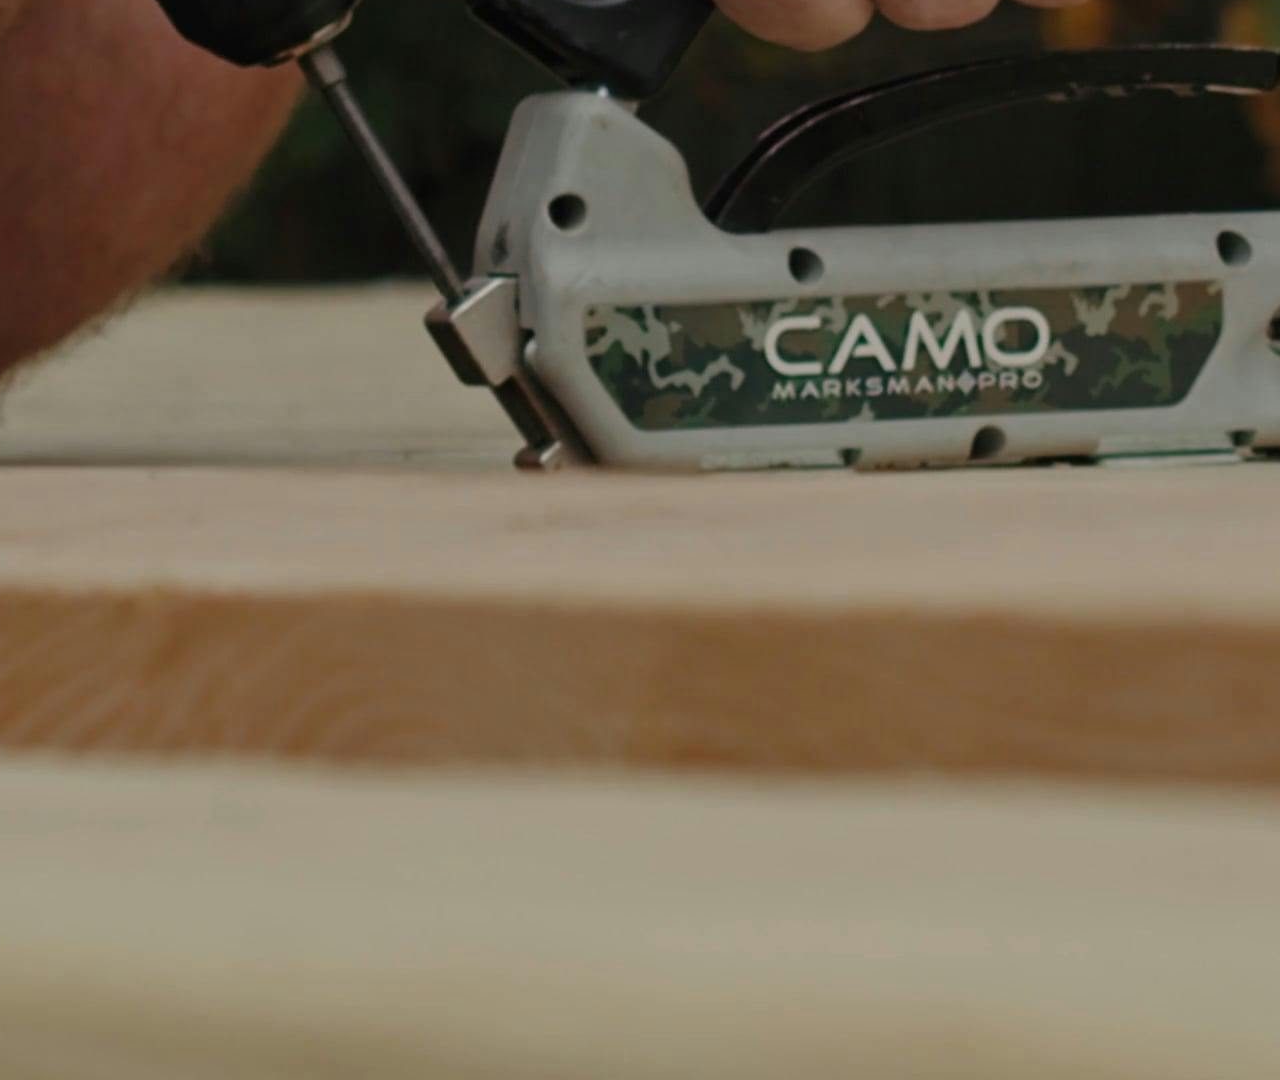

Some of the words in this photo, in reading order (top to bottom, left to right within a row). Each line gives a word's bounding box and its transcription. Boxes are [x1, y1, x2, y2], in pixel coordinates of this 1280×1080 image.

[764, 306, 1051, 377] CAMO
[771, 374, 956, 401] MARKSMAN
[977, 369, 1043, 392] PRO
